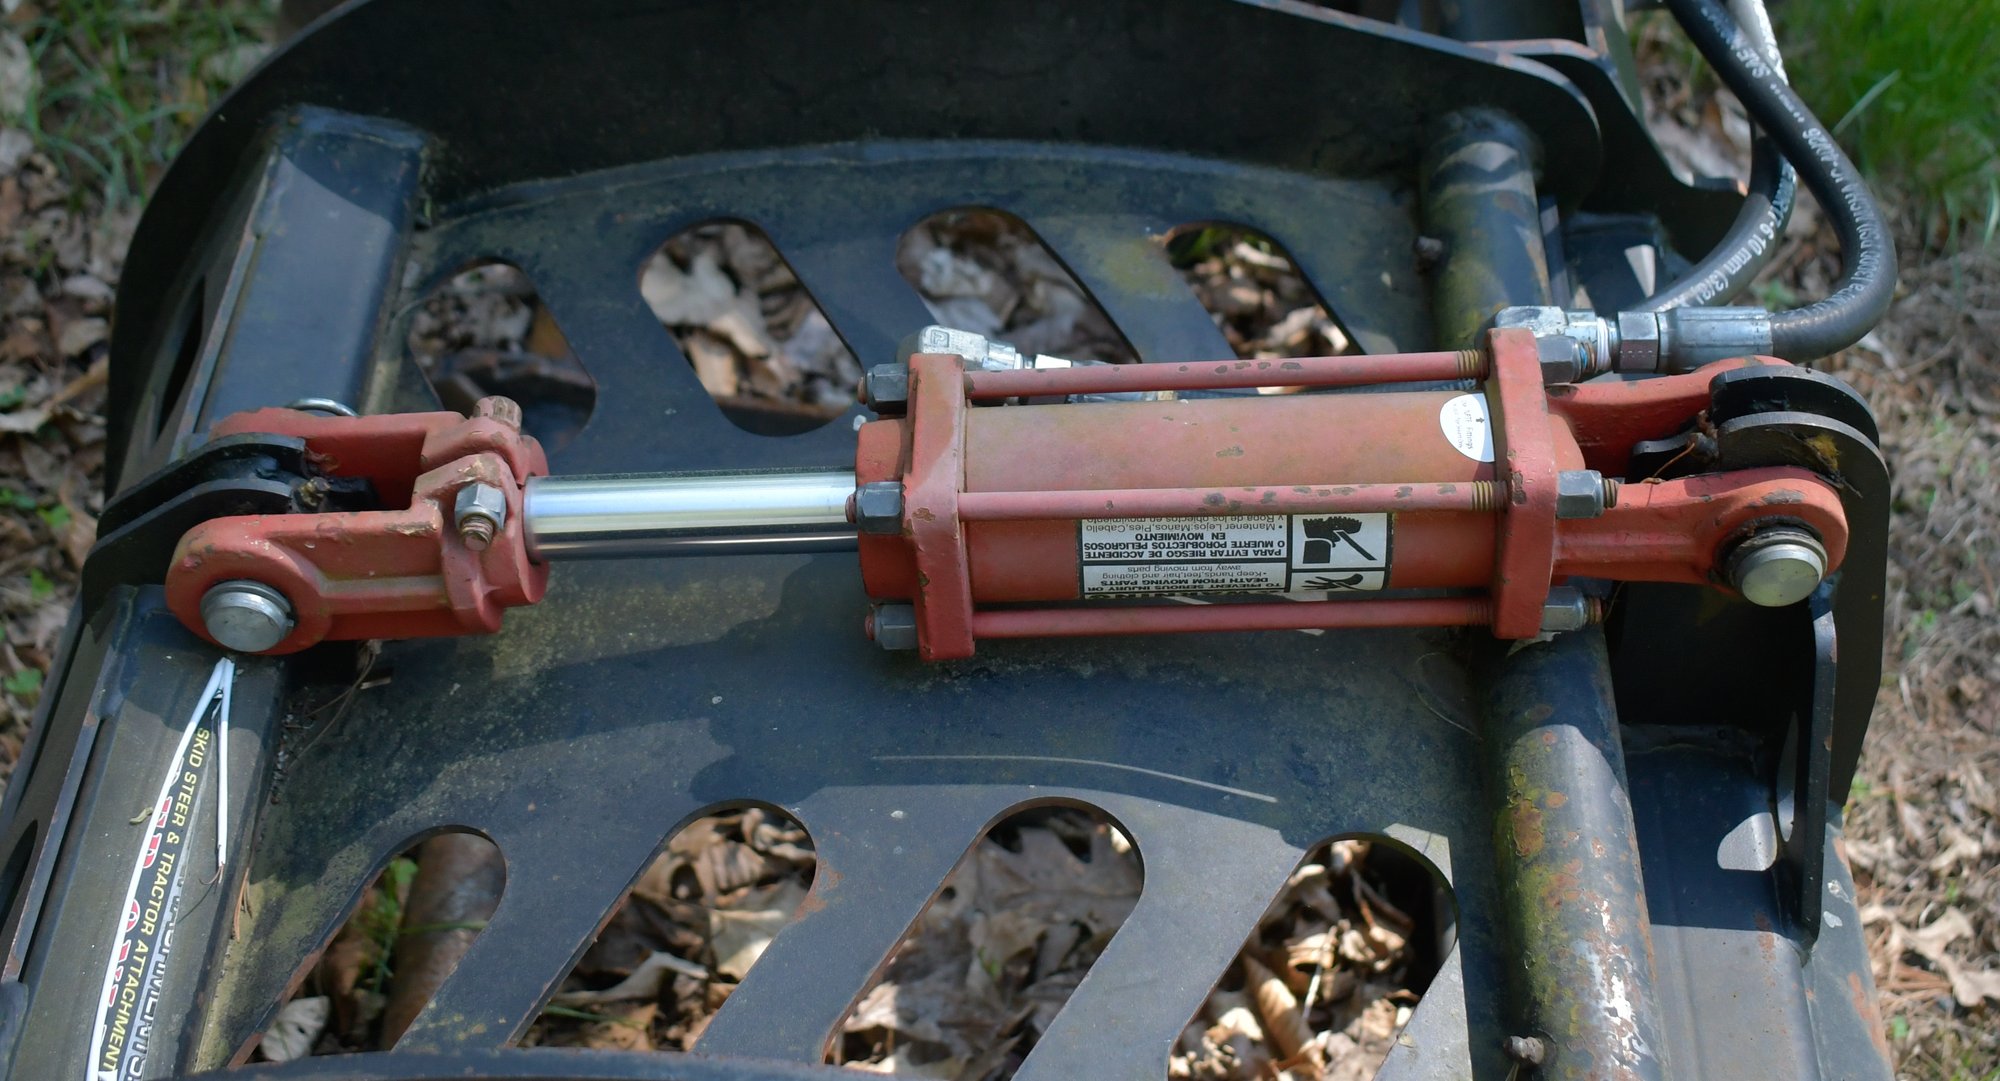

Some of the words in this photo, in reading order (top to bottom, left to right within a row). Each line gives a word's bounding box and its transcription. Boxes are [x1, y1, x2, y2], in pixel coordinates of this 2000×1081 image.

[1736, 47, 1771, 79] SAE
[1841, 183, 1877, 223] MSHA
[1748, 233, 1767, 257] 10
[1723, 247, 1753, 275] mm
[1225, 522, 1276, 531] Mantener
[1211, 532, 1226, 540] EN
[1084, 542, 1148, 550] PELIGROSOS
[1151, 541, 1227, 550] POROBJECTOS
[1231, 540, 1274, 549] MUERTE
[1084, 551, 1145, 559] ACCIDENTE
[1166, 550, 1206, 558] RIESGO
[1210, 549, 1249, 557] EVITAR
[1253, 549, 1281, 557] PARA
[1154, 565, 1188, 573] moving
[1102, 572, 1139, 580] clothing
[188, 727, 210, 768] SKID
[172, 771, 197, 827] STEER
[166, 831, 180, 845] &
[140, 852, 176, 936] TRACTOR
[103, 939, 149, 1071] ATTACHMENT
